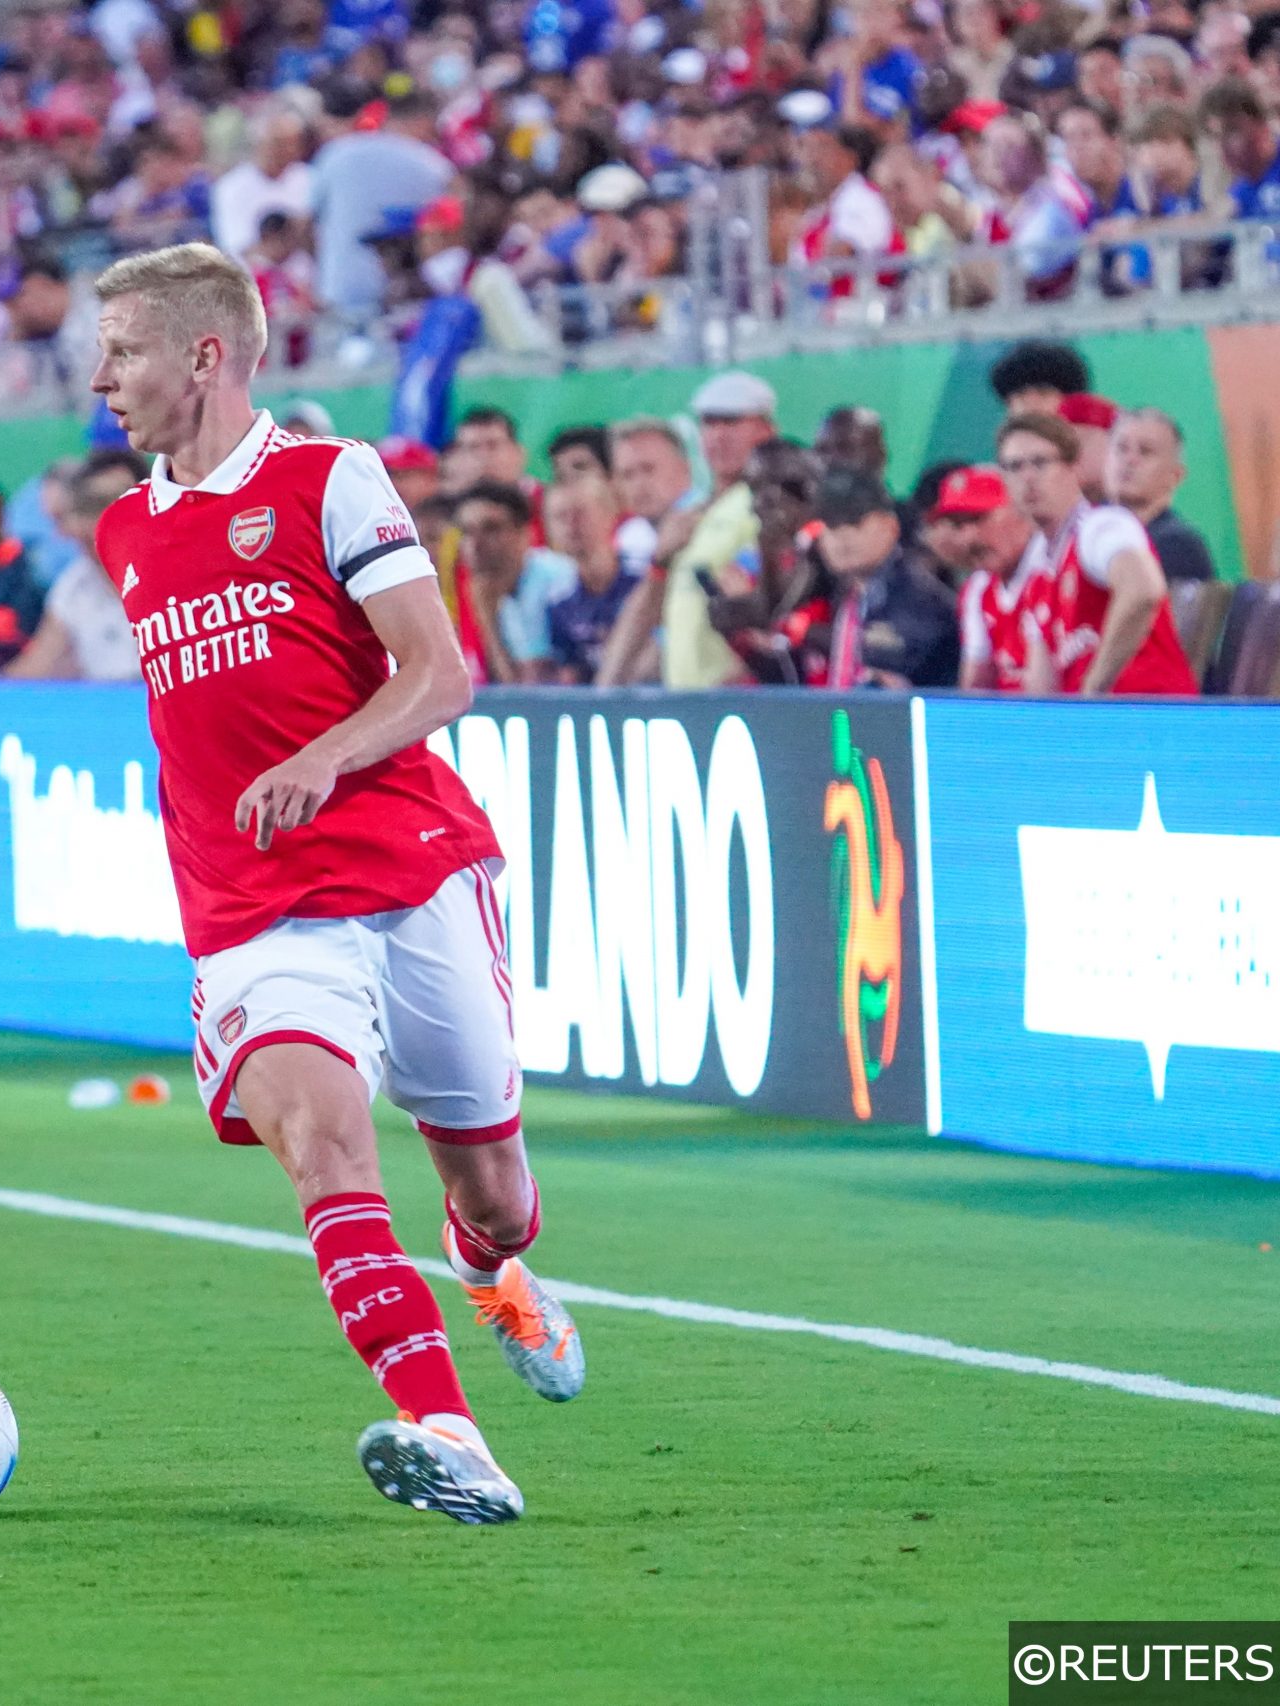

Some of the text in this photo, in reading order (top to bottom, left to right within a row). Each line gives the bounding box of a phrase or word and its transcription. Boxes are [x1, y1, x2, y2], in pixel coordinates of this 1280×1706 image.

[131, 580, 295, 657] mirates
[145, 622, 273, 700] FLY BETTER
[426, 714, 774, 1096] LANDO
[340, 1286, 404, 1334] AFC
